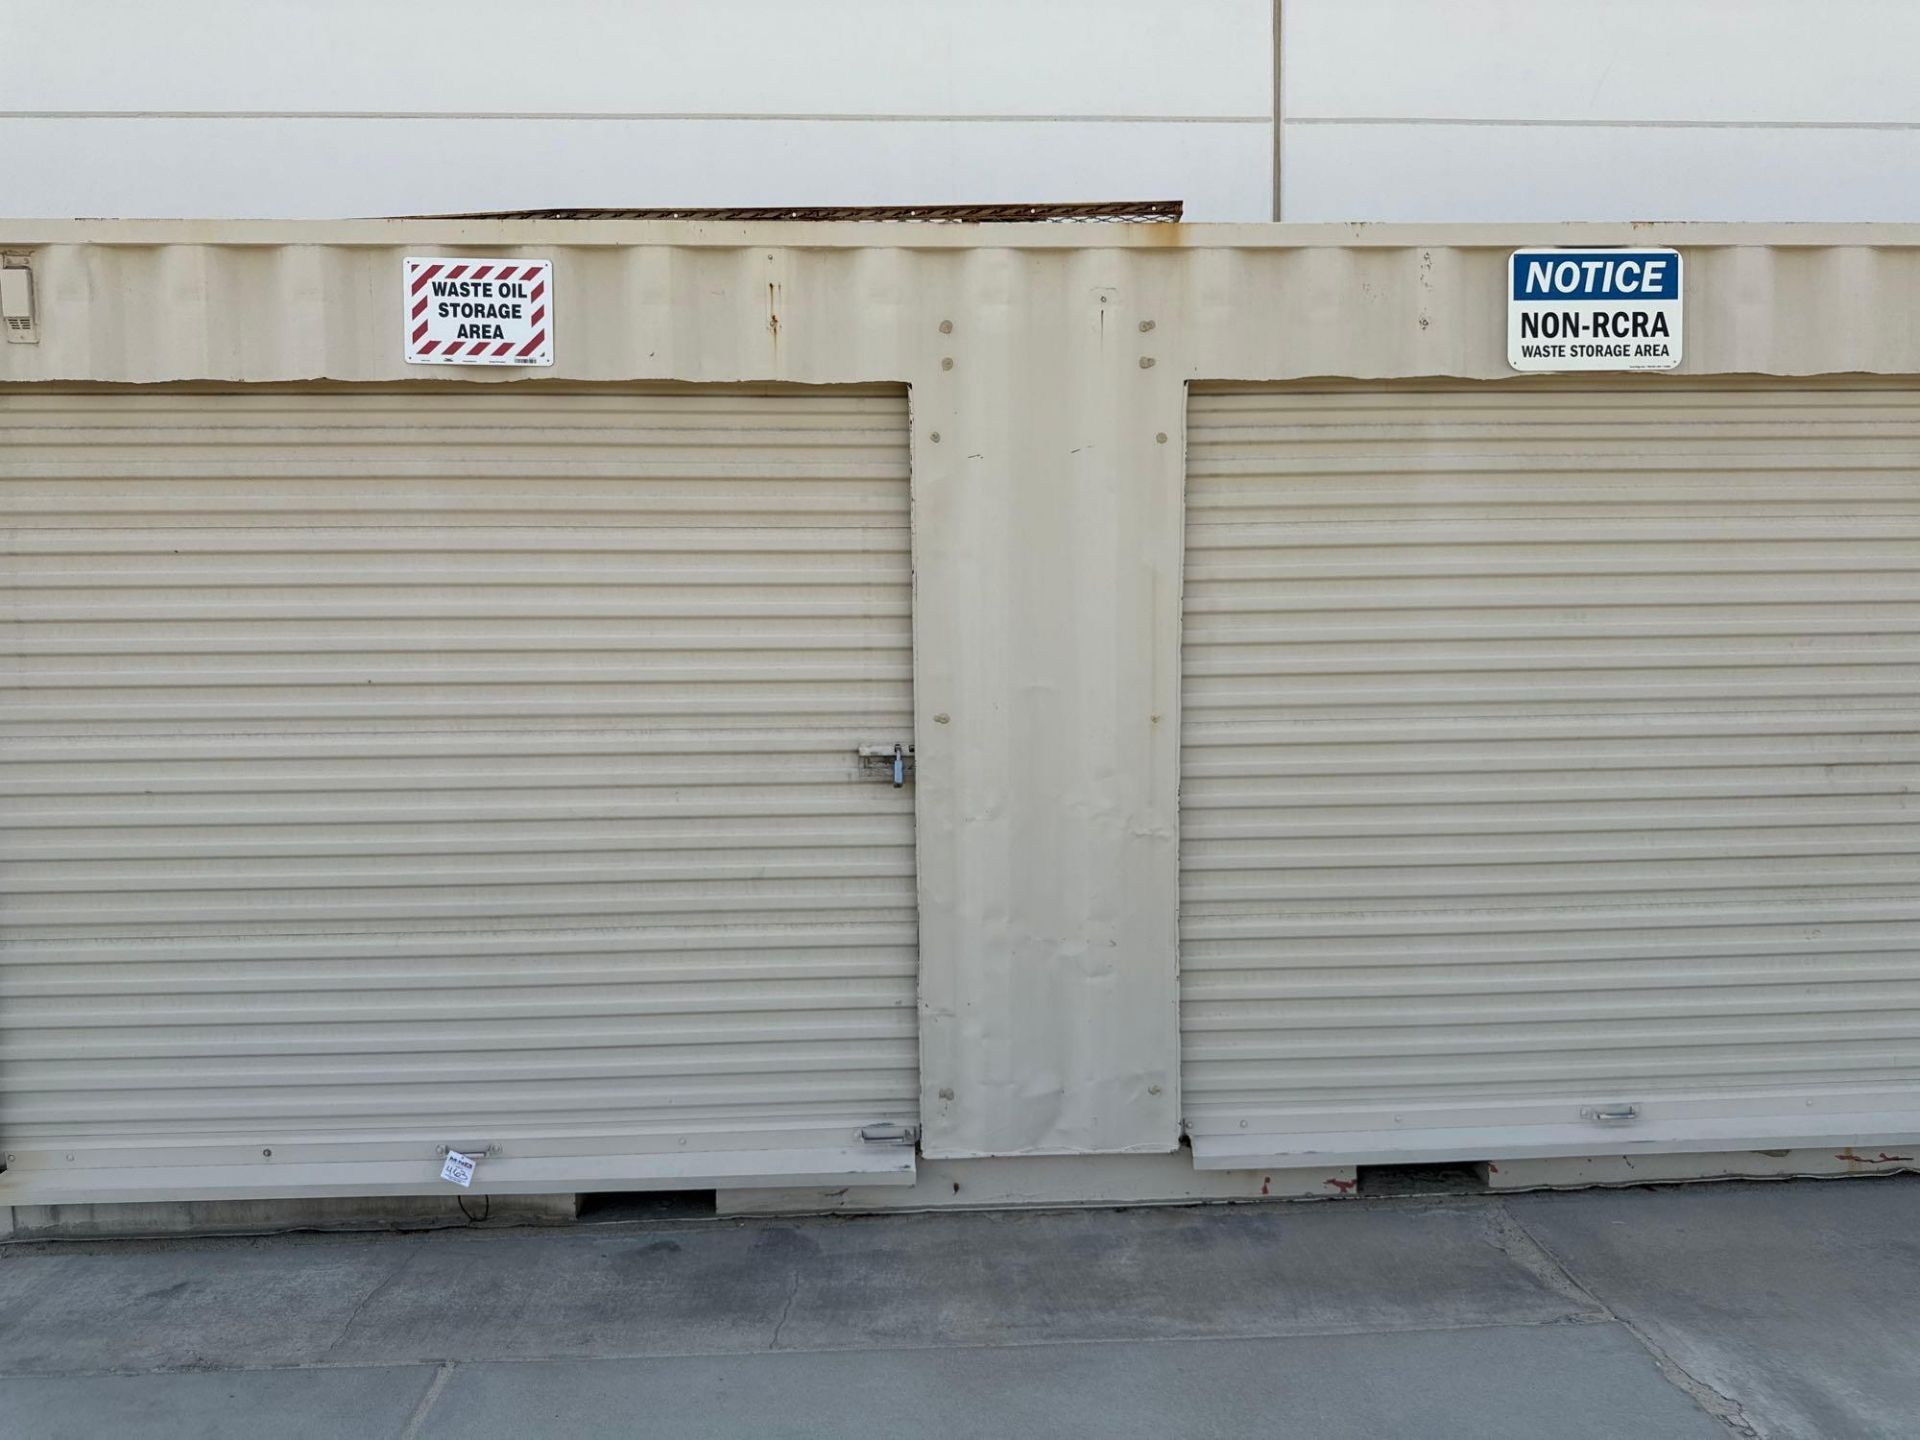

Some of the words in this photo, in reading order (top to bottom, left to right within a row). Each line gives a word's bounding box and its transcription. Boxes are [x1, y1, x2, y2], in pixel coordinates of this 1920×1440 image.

[1525, 260, 1667, 293] NOTICE
[432, 281, 492, 298] WASTE
[498, 282, 528, 298] OIL
[438, 302, 522, 319] STORAGE
[457, 323, 504, 340] AREA
[1521, 311, 1670, 339] NON-RCRA
[1522, 345, 1566, 358] WASTE
[1570, 344, 1631, 358] STORAGE
[1634, 344, 1670, 357] AREA
